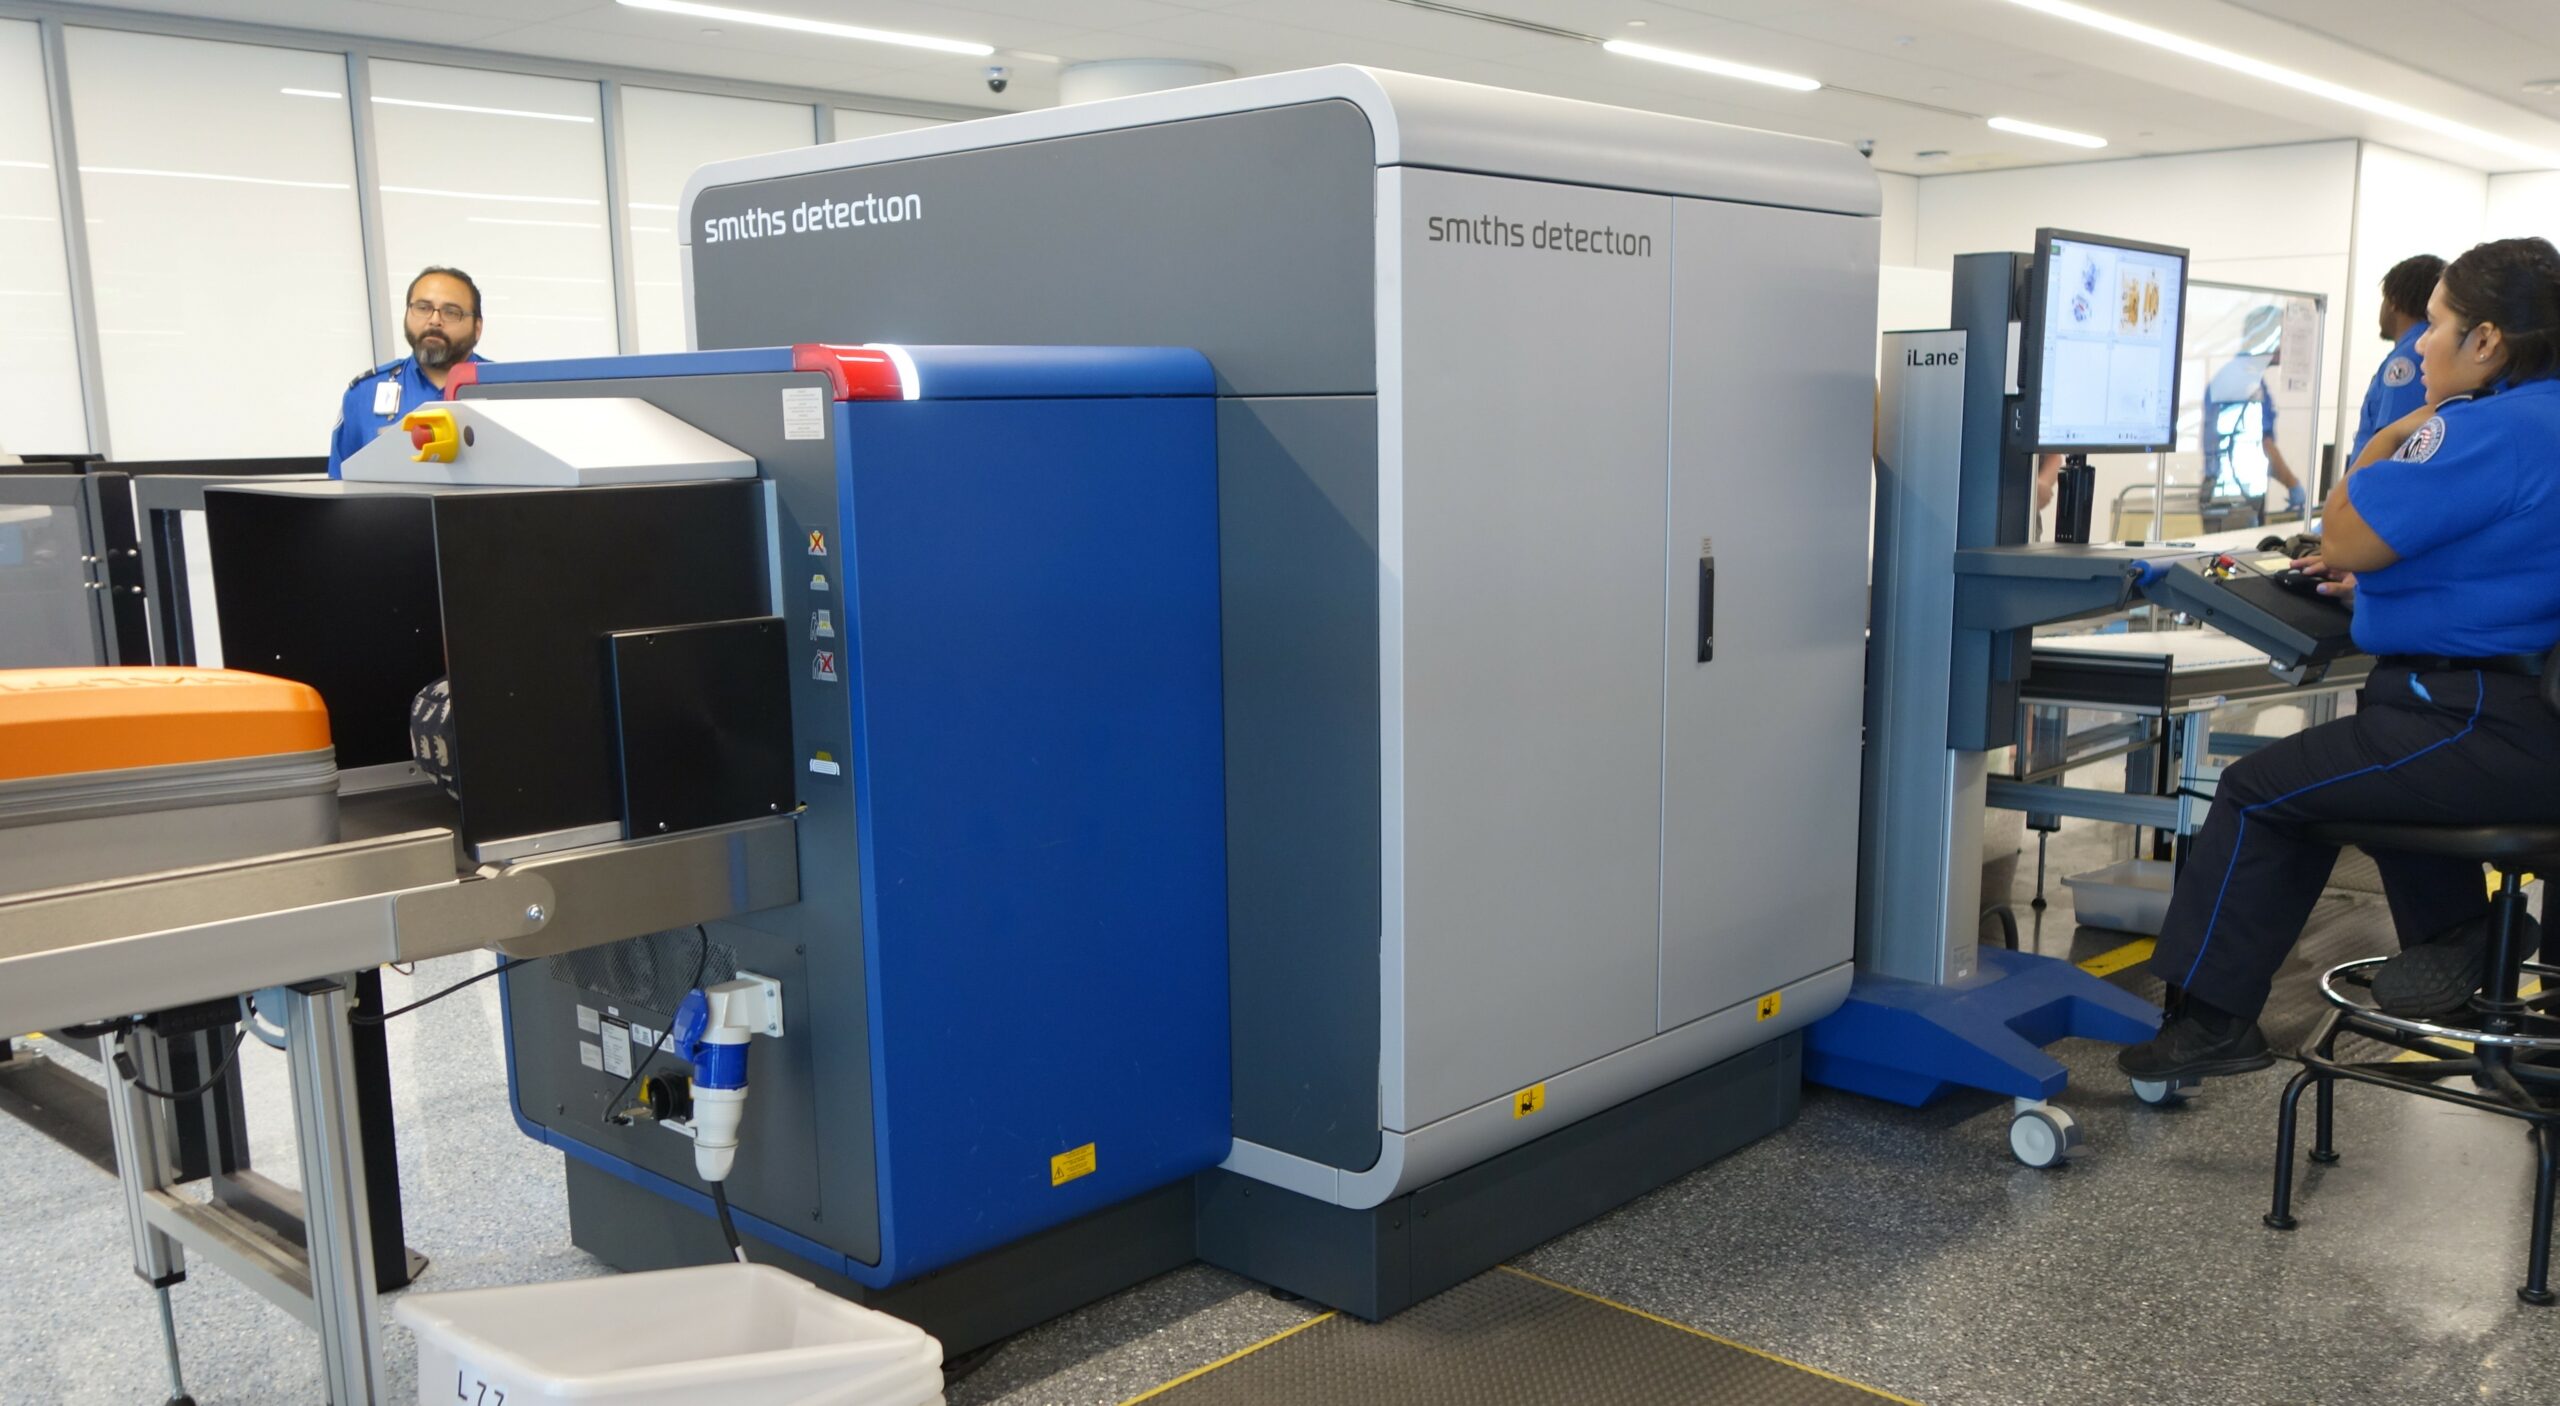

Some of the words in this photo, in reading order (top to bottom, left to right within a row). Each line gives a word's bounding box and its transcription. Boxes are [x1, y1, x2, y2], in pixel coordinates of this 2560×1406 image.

[704, 207, 787, 244] smiths
[792, 193, 922, 234] detection
[1428, 214, 1525, 247] smiths
[1532, 220, 1651, 258] detection
[1907, 349, 1959, 366] iLane
